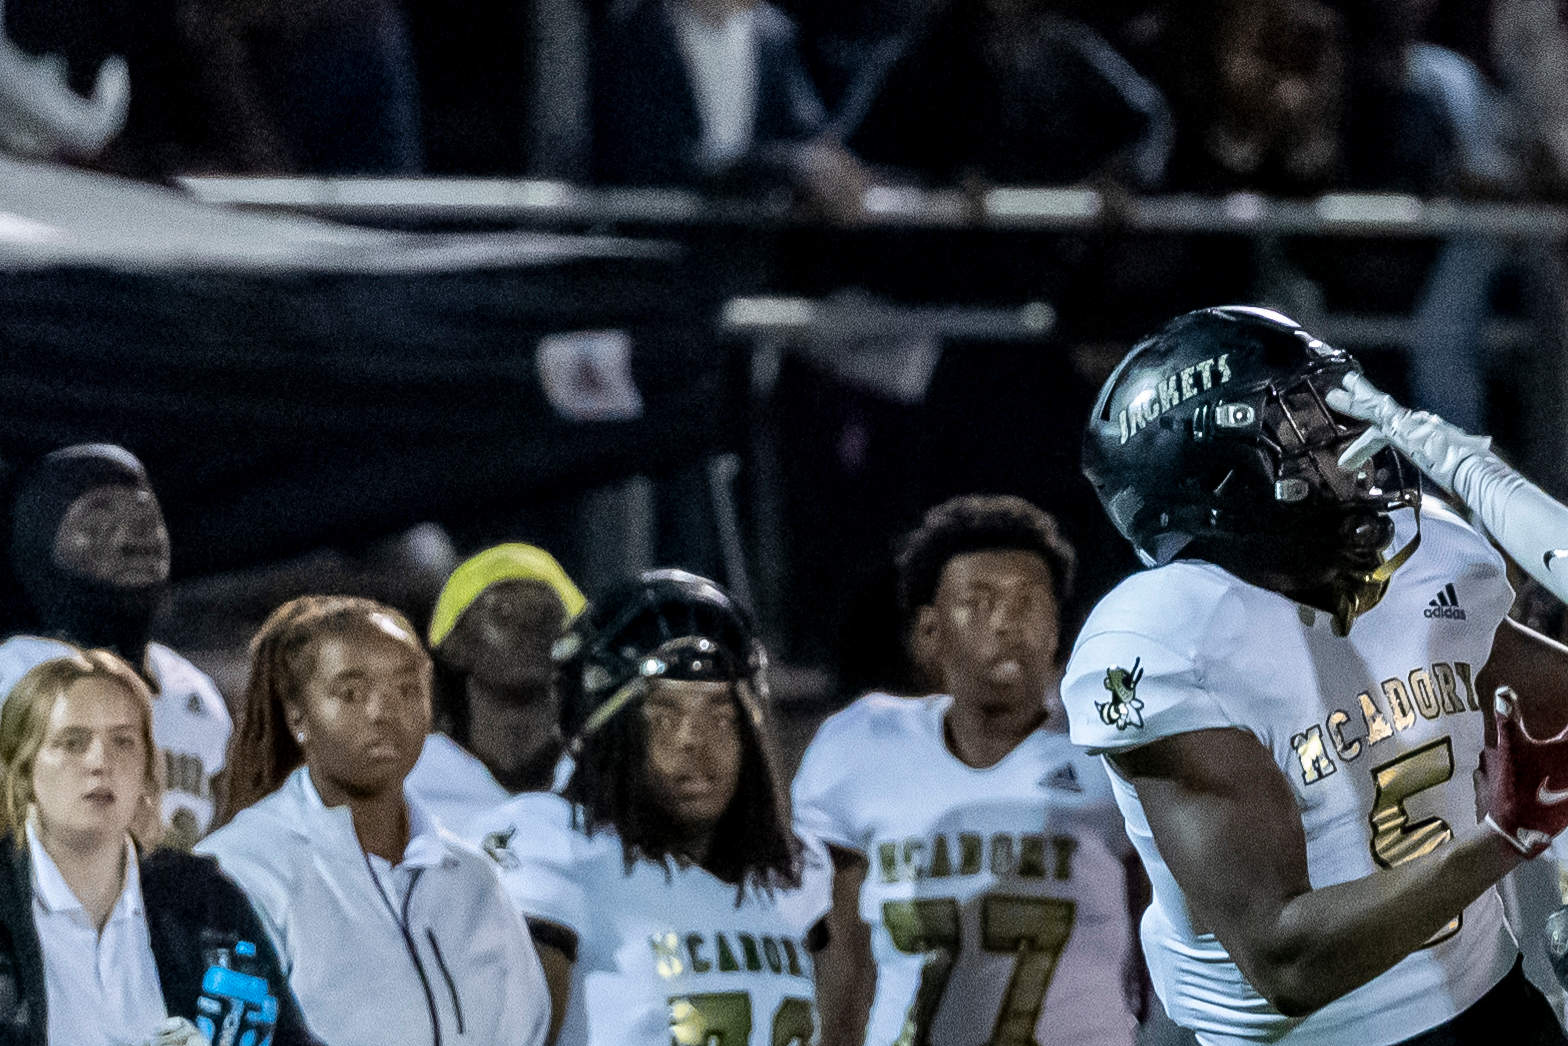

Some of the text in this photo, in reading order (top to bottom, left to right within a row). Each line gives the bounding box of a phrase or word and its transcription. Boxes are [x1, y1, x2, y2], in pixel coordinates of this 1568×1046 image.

[1119, 353, 1232, 445] JACKETS
[1423, 606, 1467, 621] adidas
[1291, 661, 1481, 786] MCADORY
